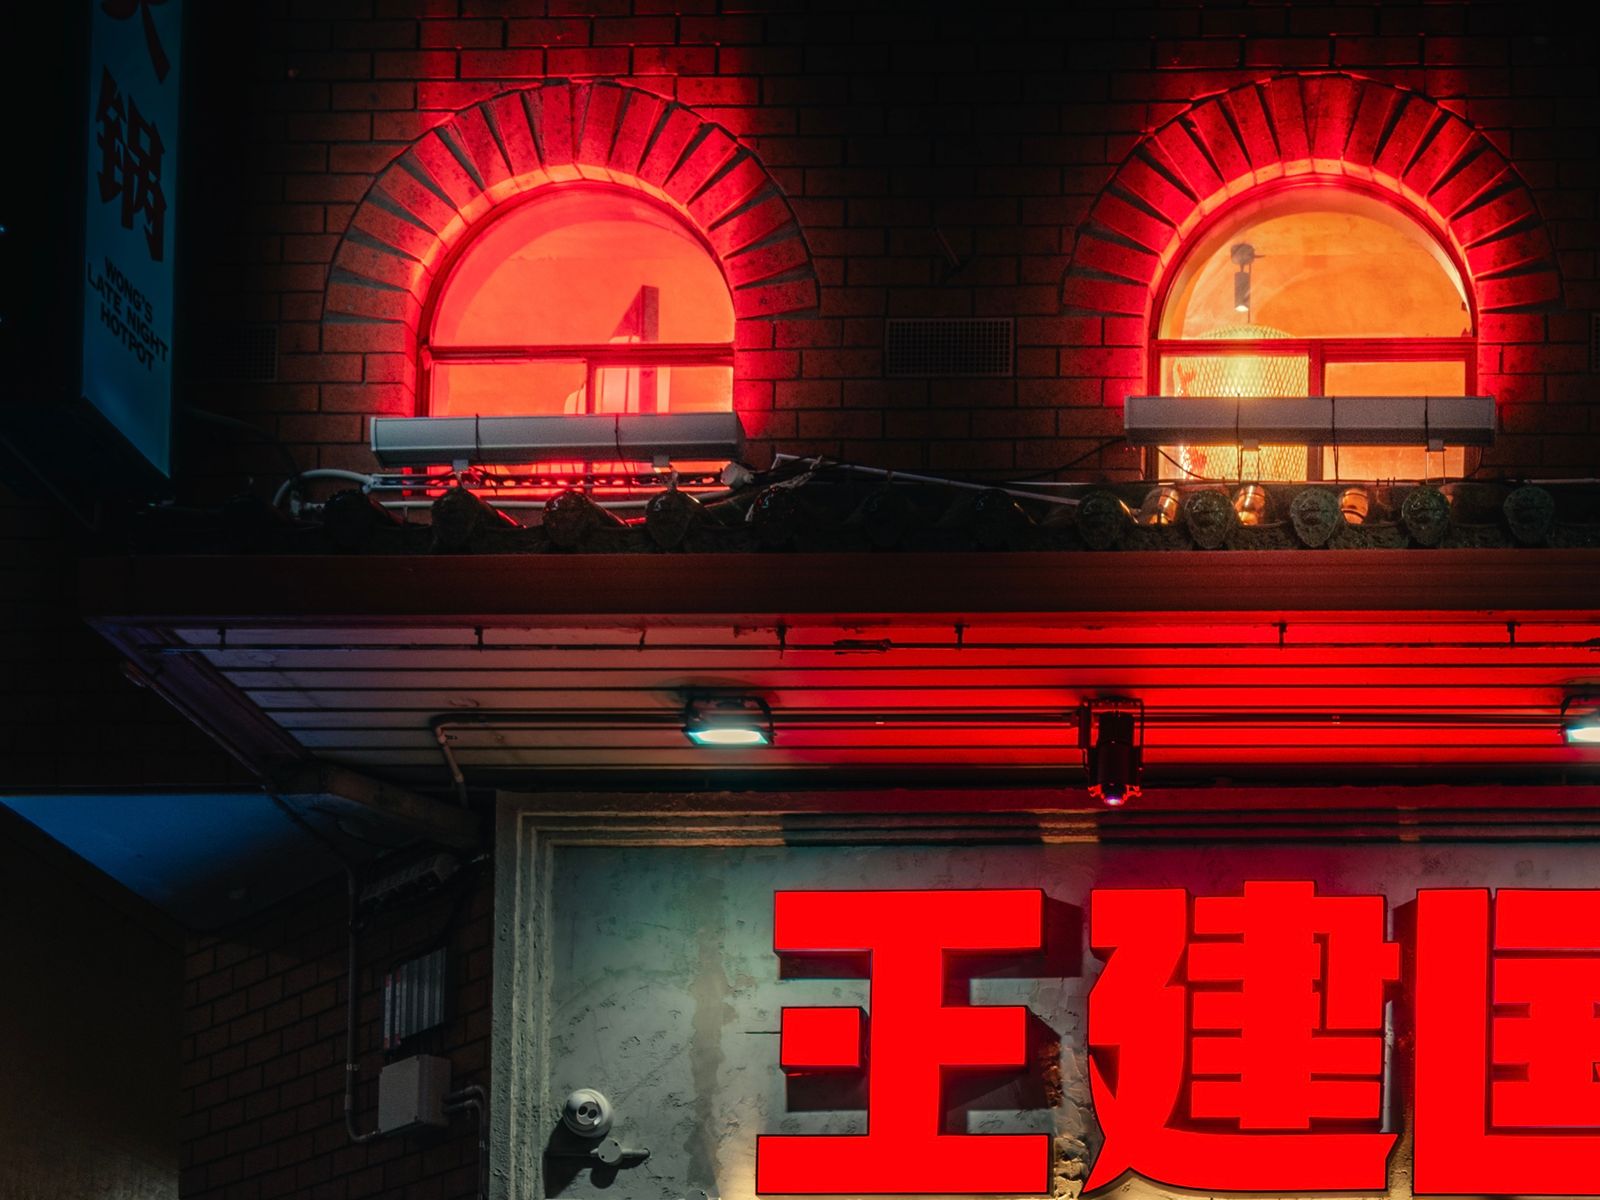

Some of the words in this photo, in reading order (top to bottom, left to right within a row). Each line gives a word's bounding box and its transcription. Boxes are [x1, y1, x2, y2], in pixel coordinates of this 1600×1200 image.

[87, 261, 121, 315] LATE
[127, 305, 168, 363] NIGHT
[105, 255, 154, 323] WONG'S
[100, 300, 155, 373] HOTPOT
